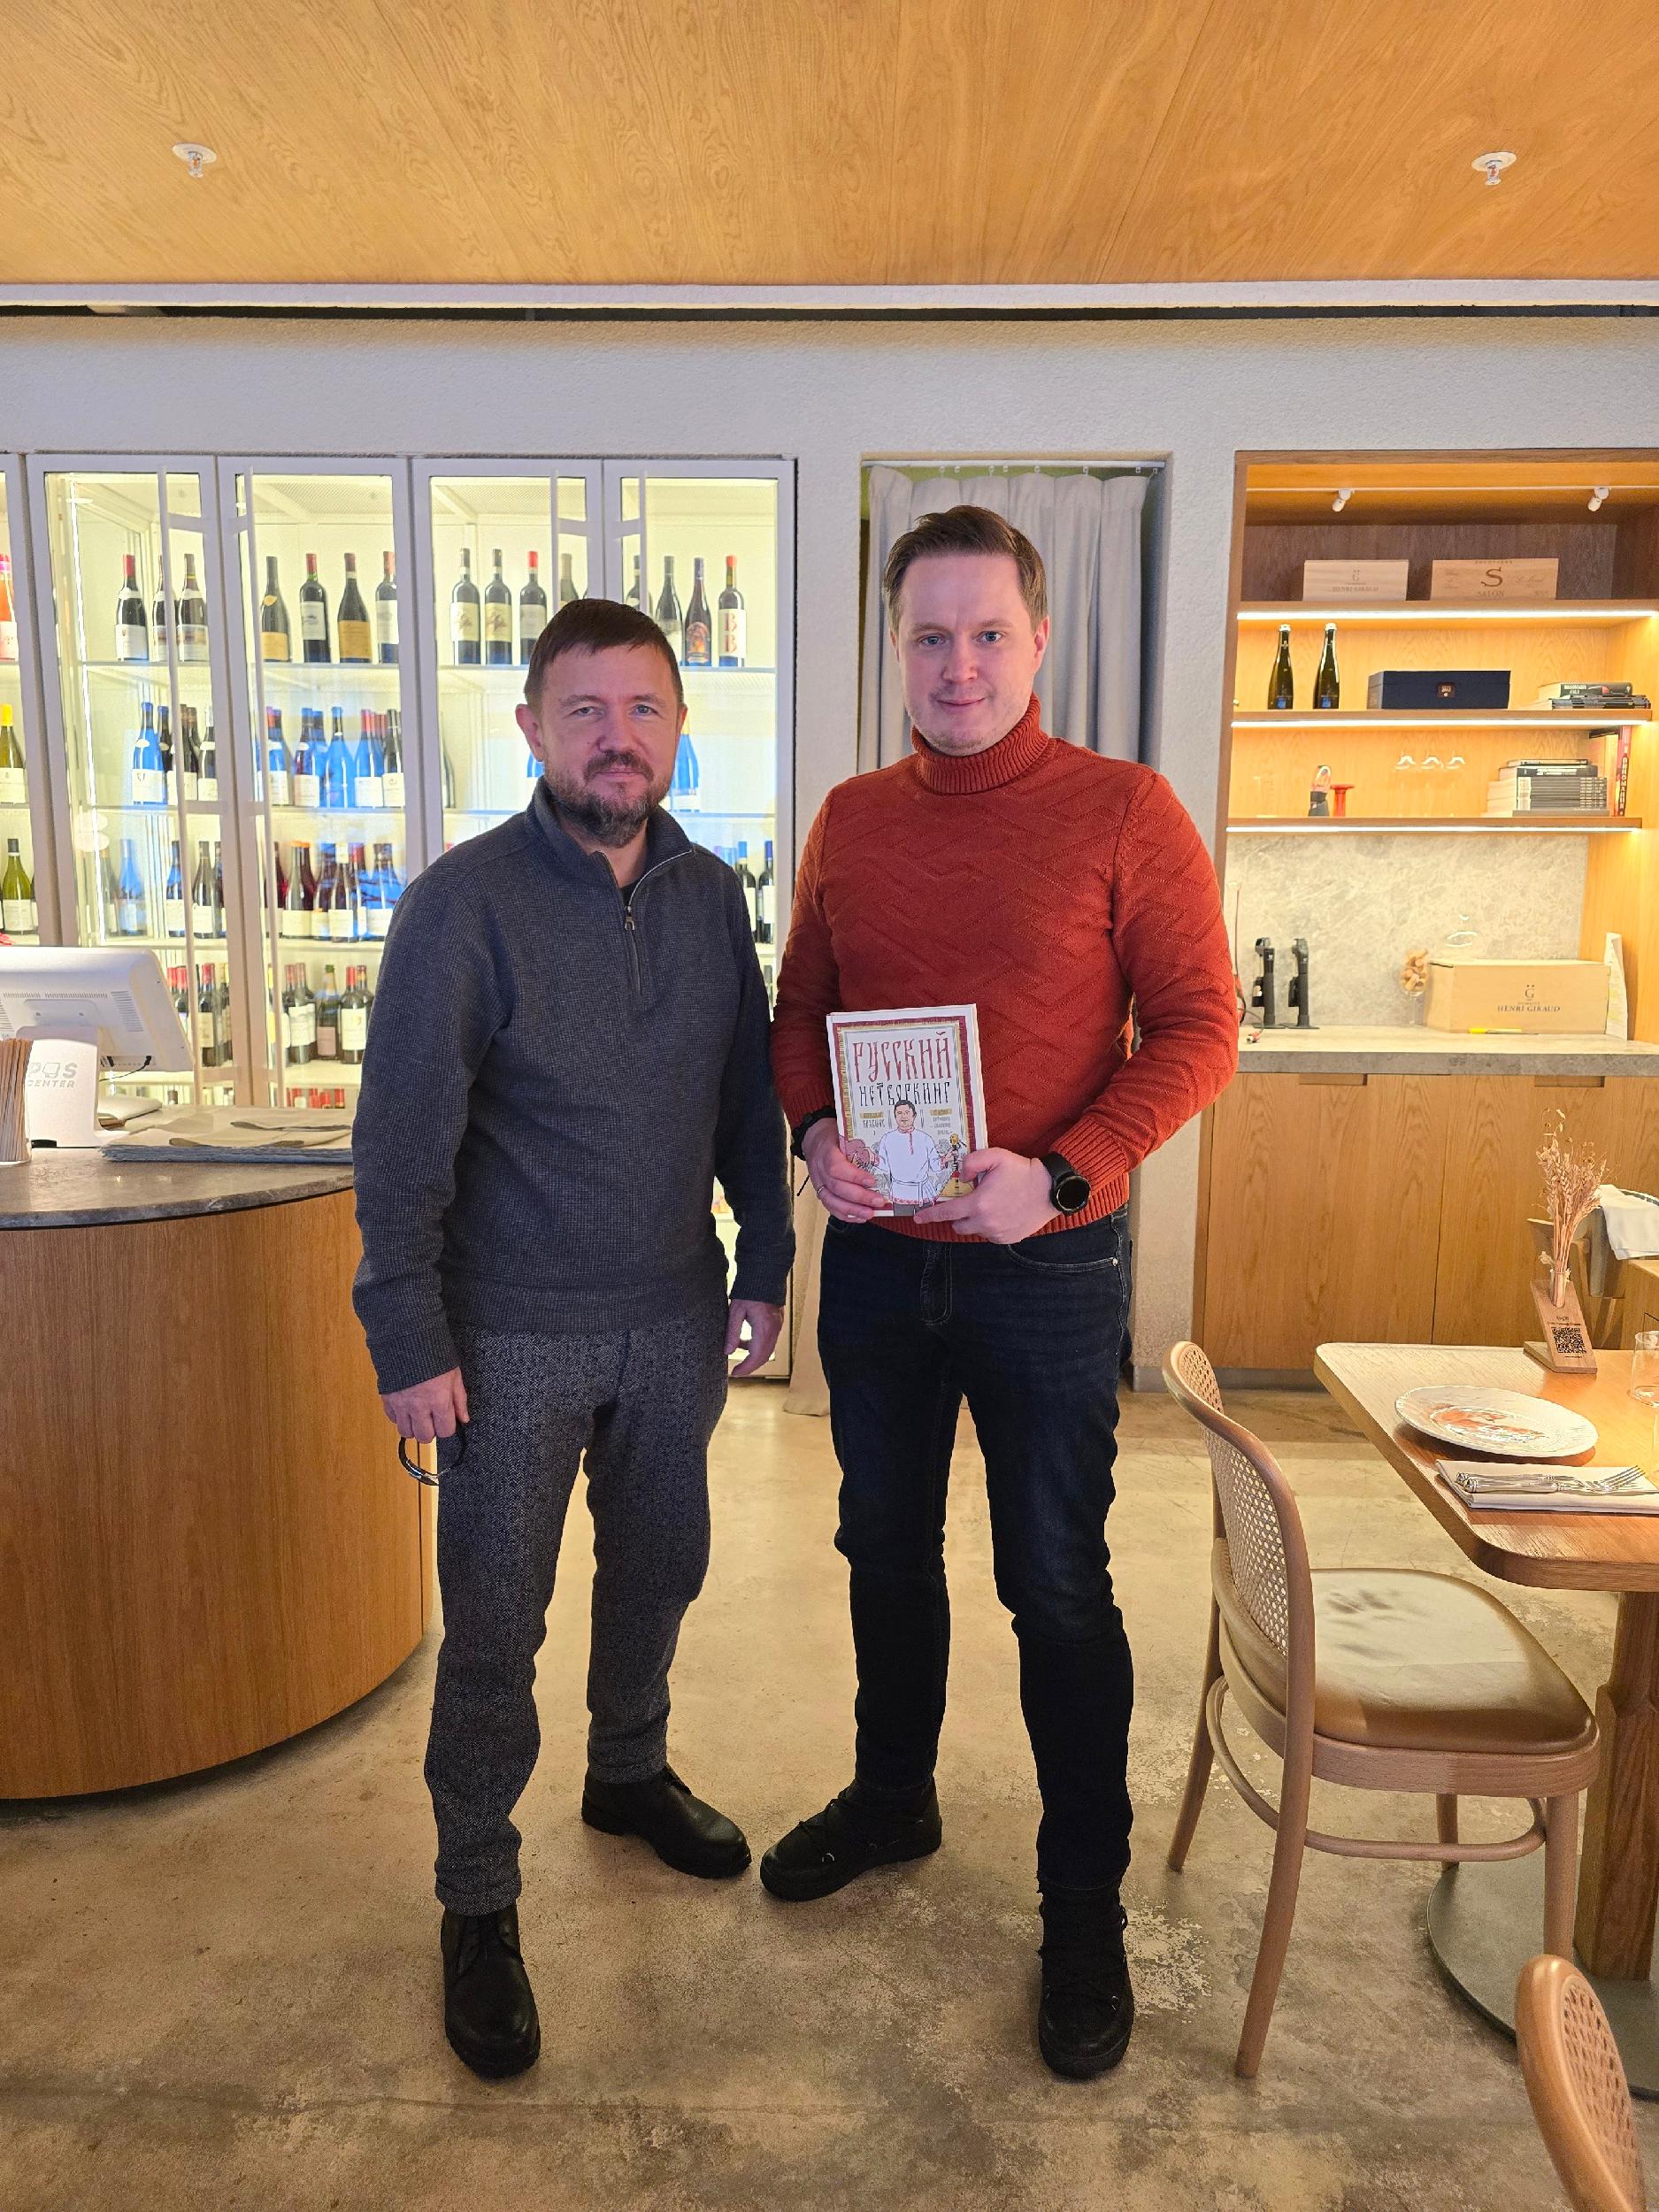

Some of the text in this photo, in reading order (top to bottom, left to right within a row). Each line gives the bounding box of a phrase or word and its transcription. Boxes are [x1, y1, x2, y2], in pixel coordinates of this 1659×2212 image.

[1480, 566, 1503, 588] S
[852, 1030, 952, 1083] РУССКИЙ
[858, 1081, 951, 1107] НЕТВОРКИНГ
